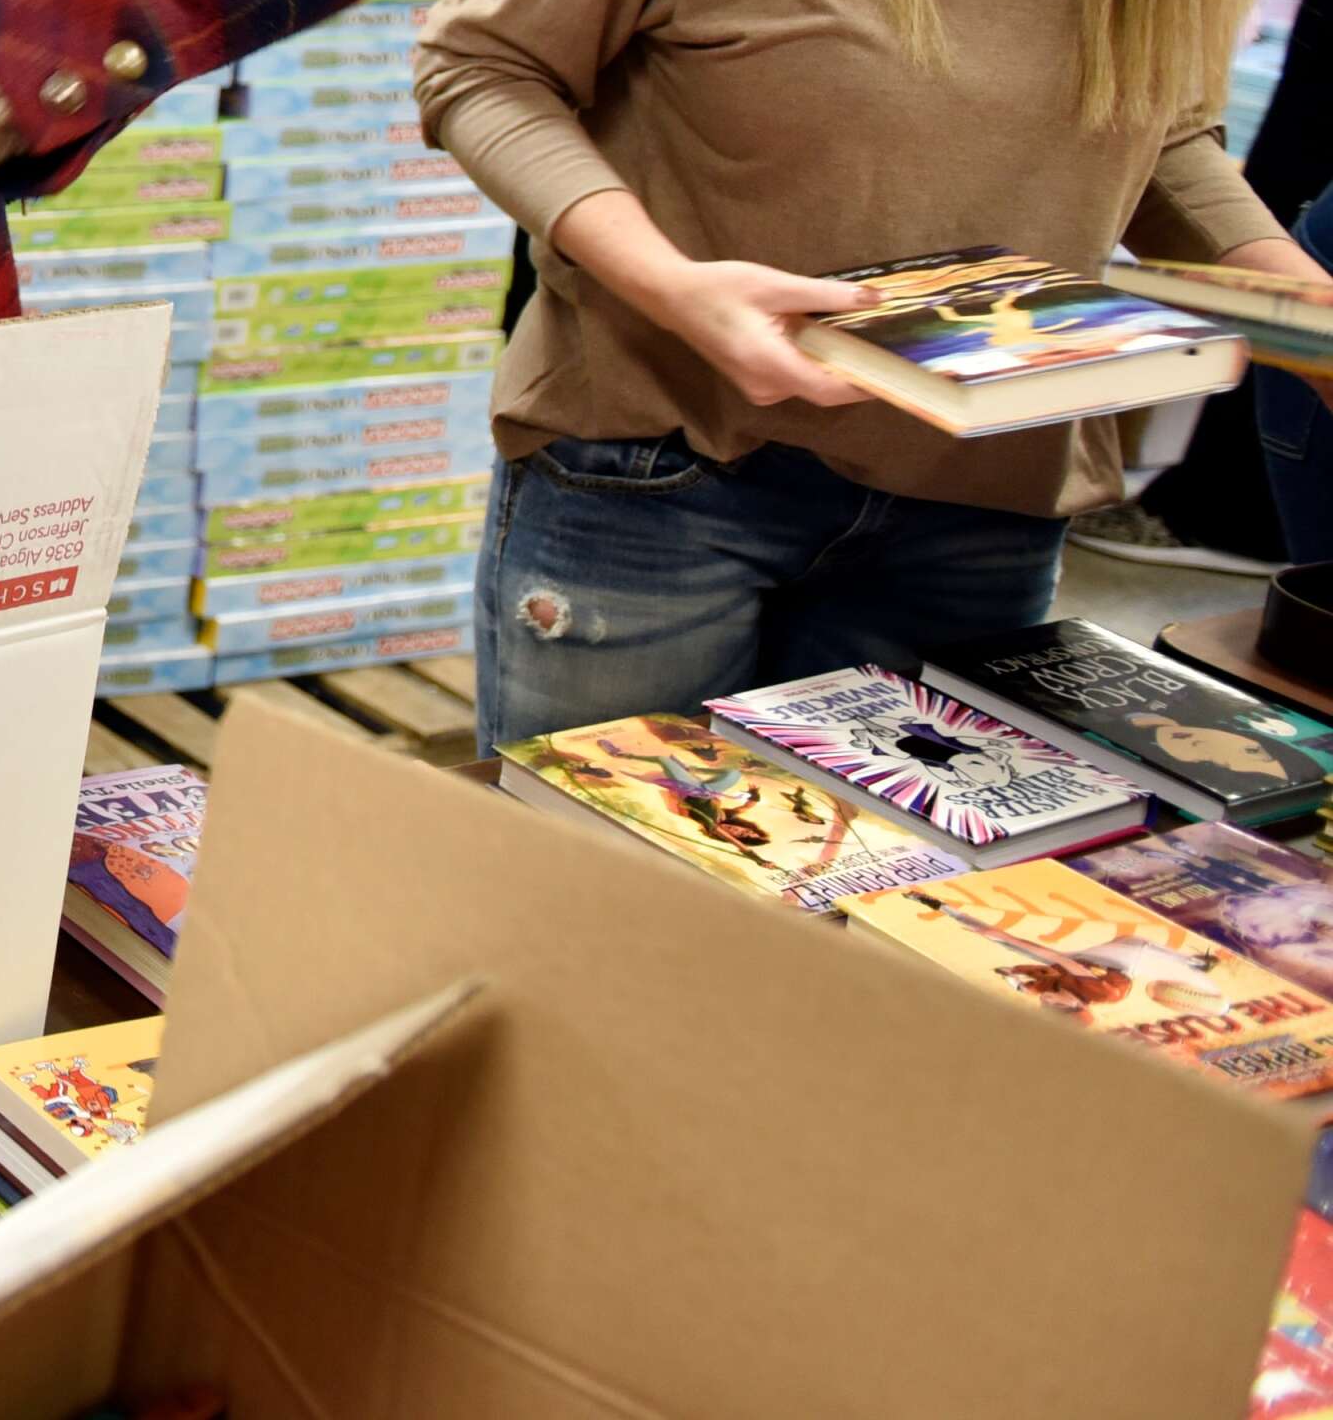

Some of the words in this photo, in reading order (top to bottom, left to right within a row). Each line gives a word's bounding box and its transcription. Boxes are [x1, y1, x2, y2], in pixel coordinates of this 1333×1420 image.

[33, 495, 95, 517] Address
[18, 518, 90, 542] Jefferson
[0, 546, 41, 568] Algoa
[45, 540, 84, 559] 6336
[1030, 655, 1138, 693] CROW
[1064, 670, 1186, 709] BLACK
[766, 682, 901, 720] INVINCIBLE
[831, 697, 908, 723] HARRIET
[944, 767, 1075, 806] PRINCESS
[973, 780, 1096, 820] HAMSTER
[891, 853, 955, 884] PILAR
